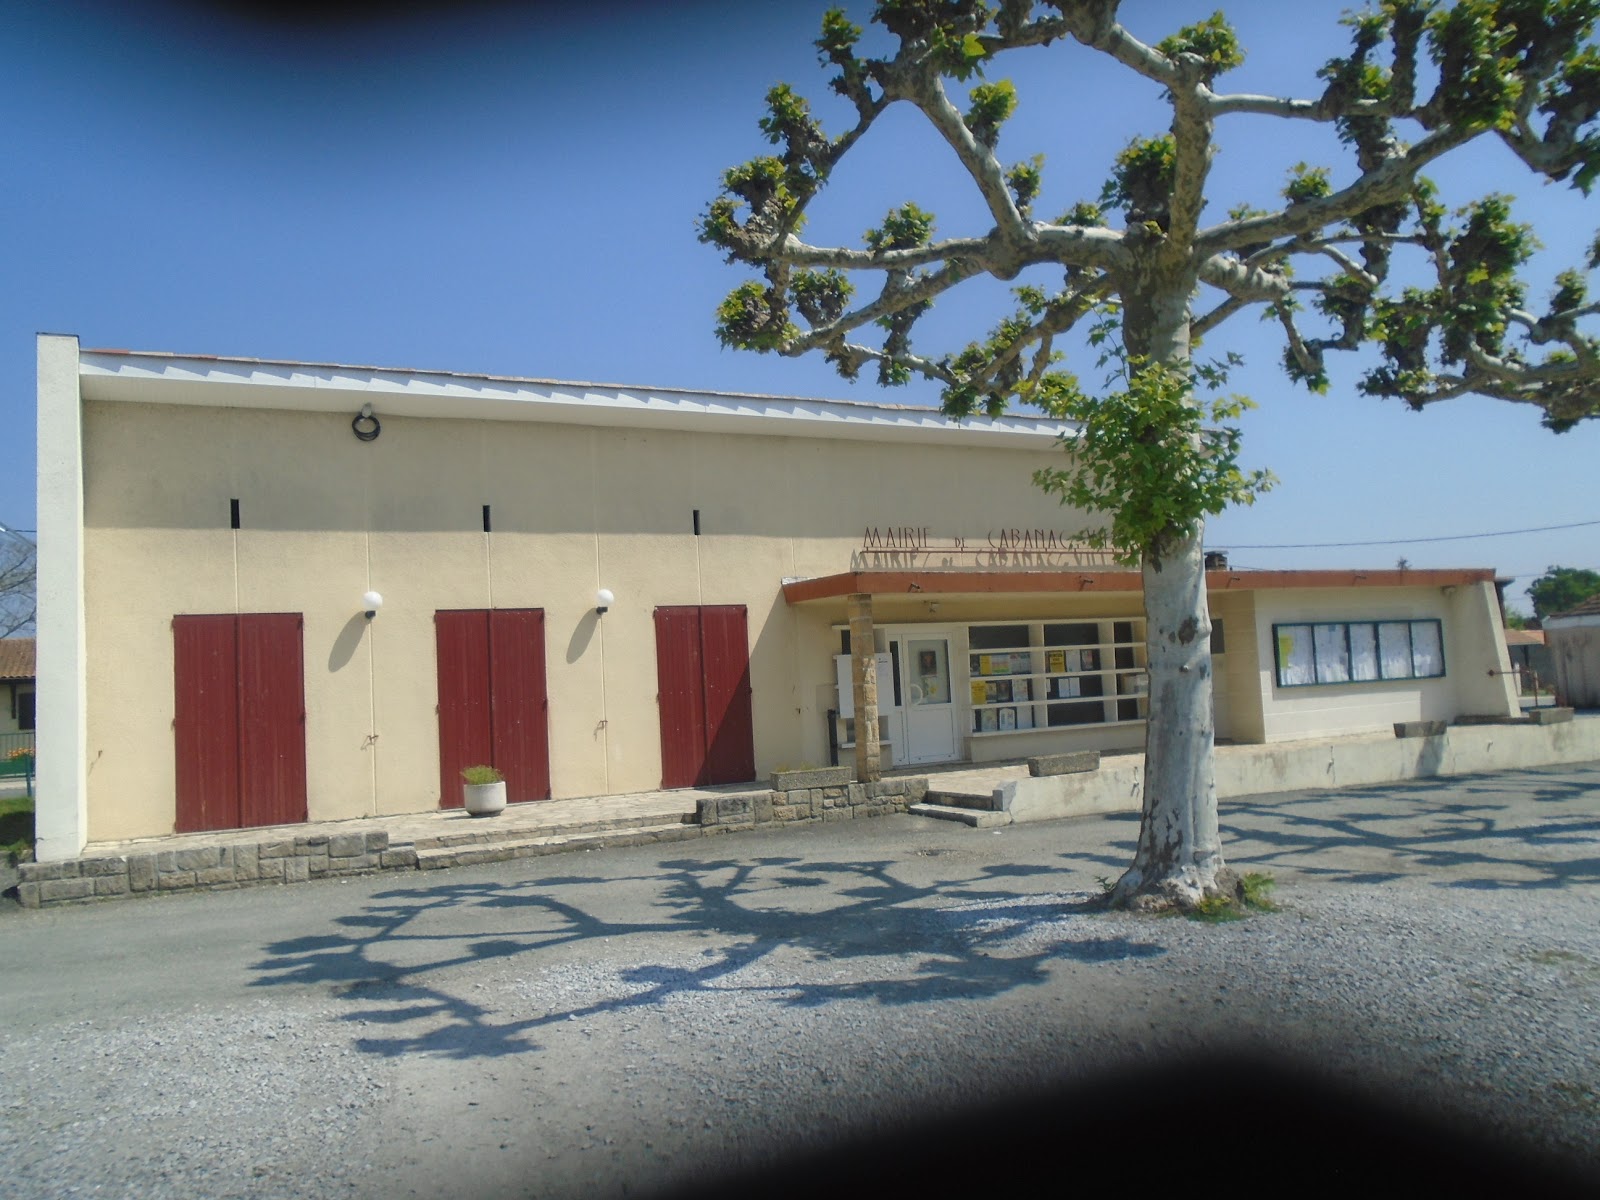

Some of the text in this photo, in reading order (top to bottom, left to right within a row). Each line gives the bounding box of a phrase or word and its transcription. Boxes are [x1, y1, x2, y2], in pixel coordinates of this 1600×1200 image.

[864, 526, 932, 548] MAIRIE
[954, 537, 968, 549] DE
[987, 527, 1068, 549] CABANAC
